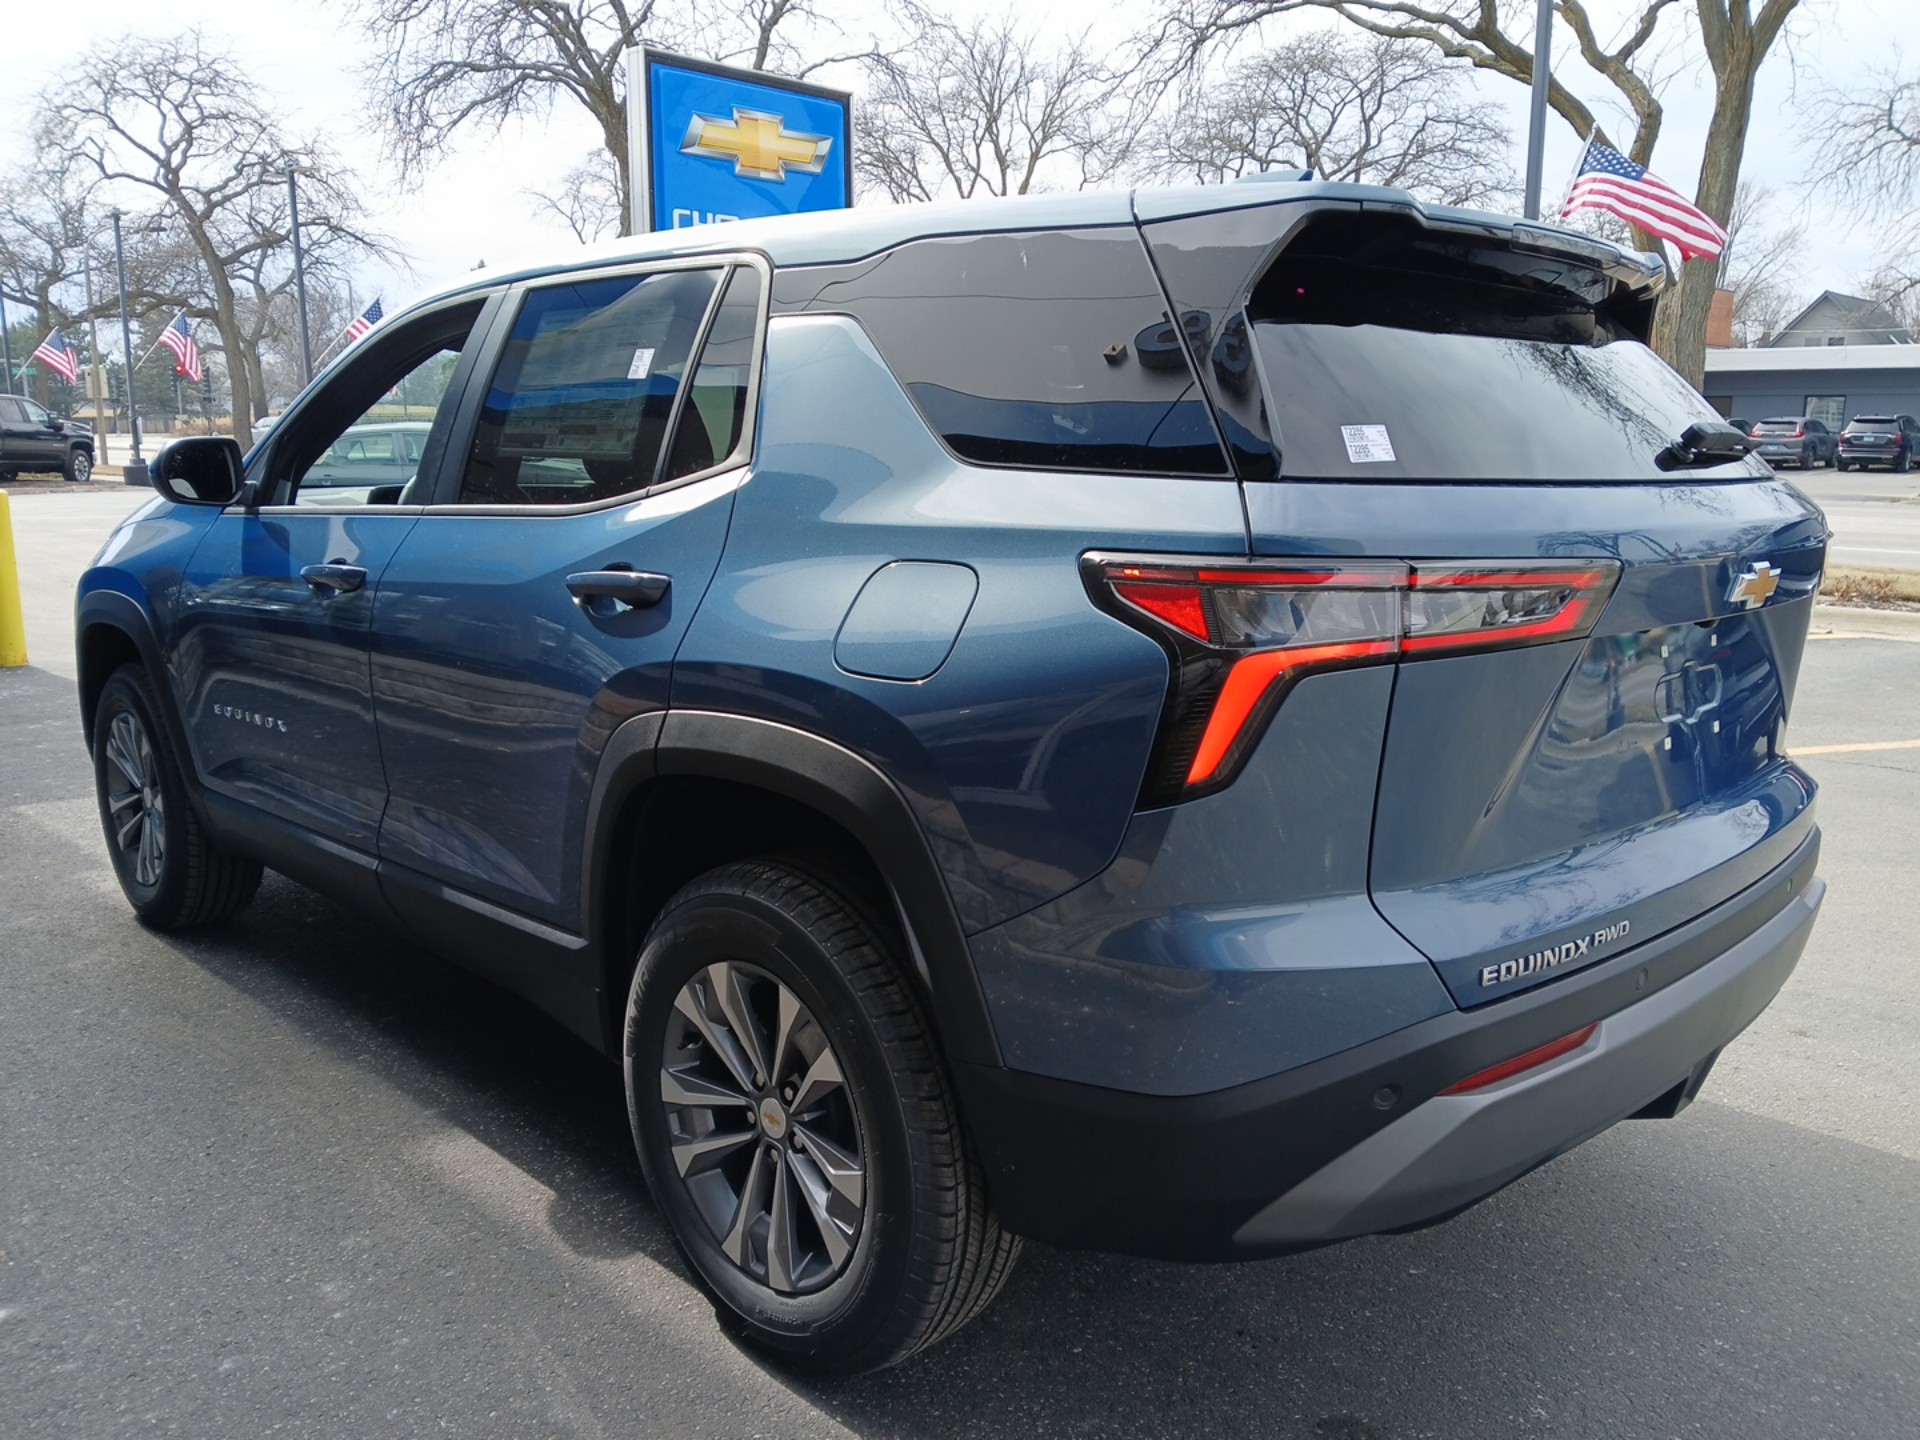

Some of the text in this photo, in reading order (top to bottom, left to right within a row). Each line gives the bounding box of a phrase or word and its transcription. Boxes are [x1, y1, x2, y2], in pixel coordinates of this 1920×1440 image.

[213, 703, 288, 733] EQUINOX
[1481, 919, 1631, 988] EQUINOX AWD
